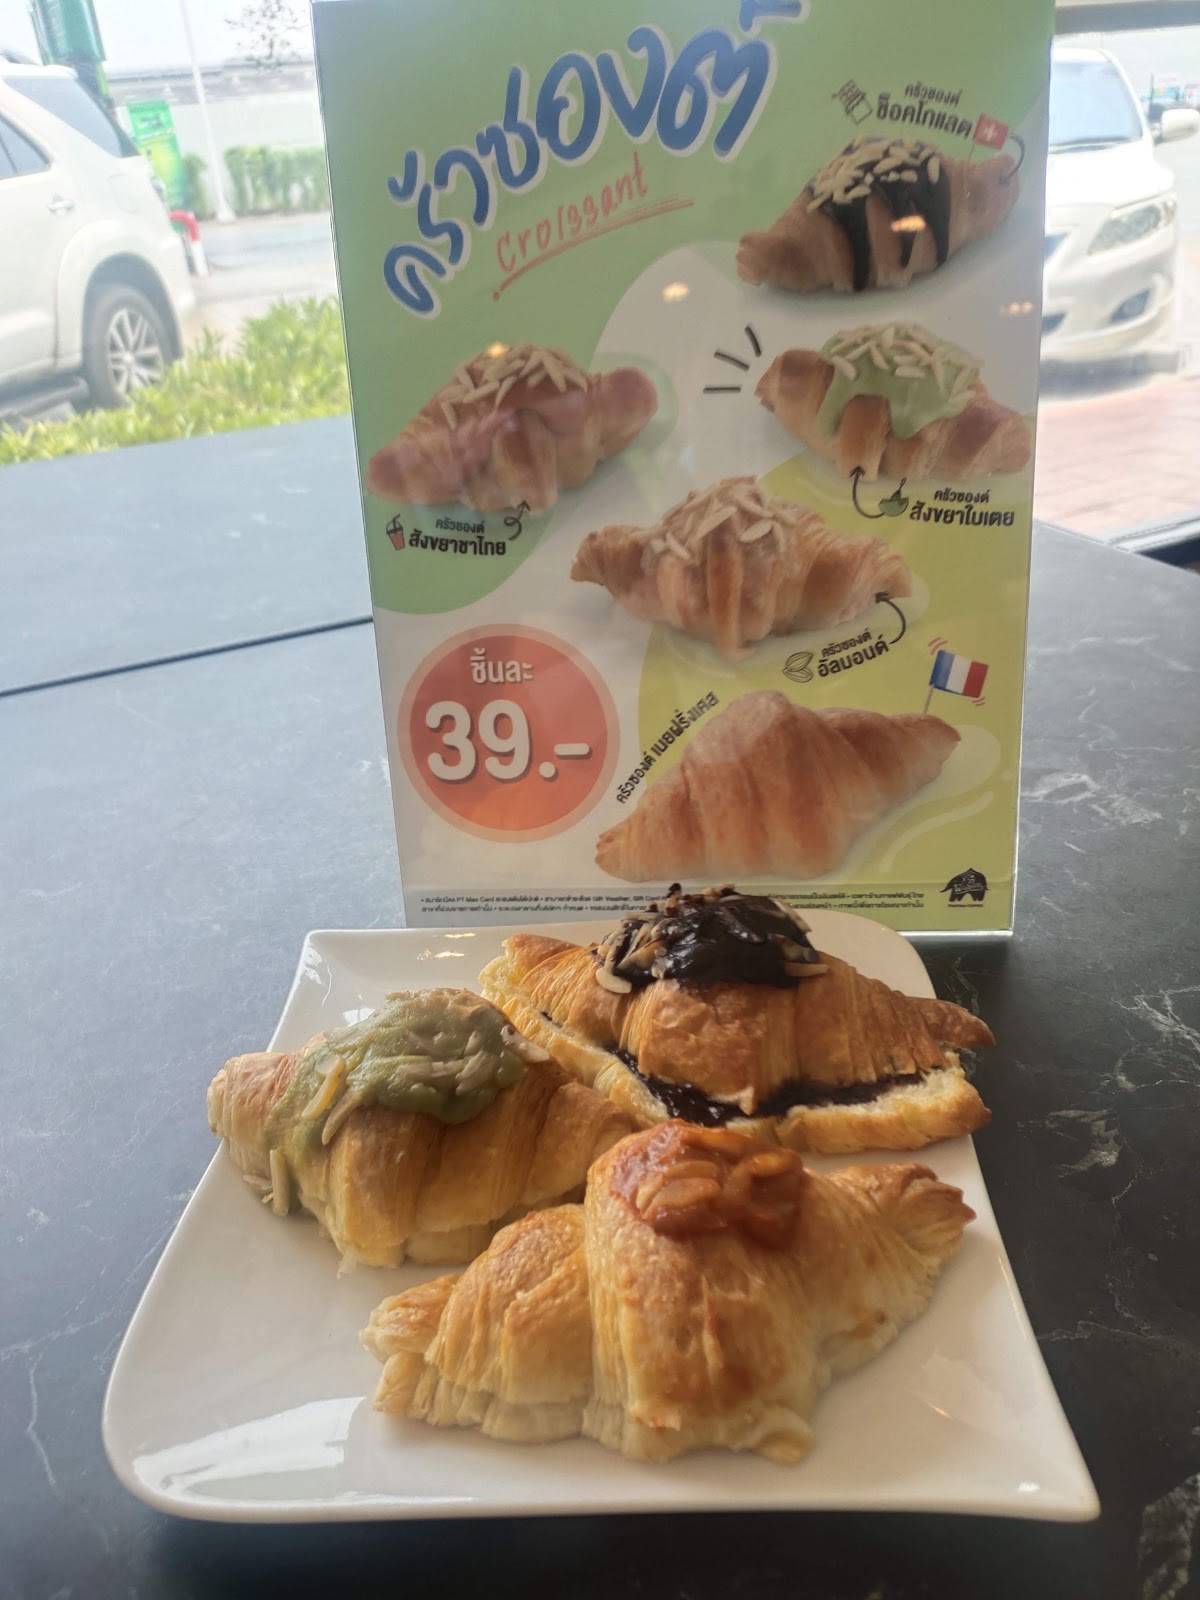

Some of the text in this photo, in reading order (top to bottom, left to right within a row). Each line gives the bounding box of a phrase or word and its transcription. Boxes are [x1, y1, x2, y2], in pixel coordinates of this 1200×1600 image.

[497, 151, 649, 273] Croissant
[910, 501, 1015, 527] สังขยาใบเตย
[409, 528, 507, 556] สังขยาชาไทย
[470, 648, 534, 684] ชิ้นละ
[817, 633, 889, 678] อัลมอนด์
[425, 699, 592, 781] 39.-
